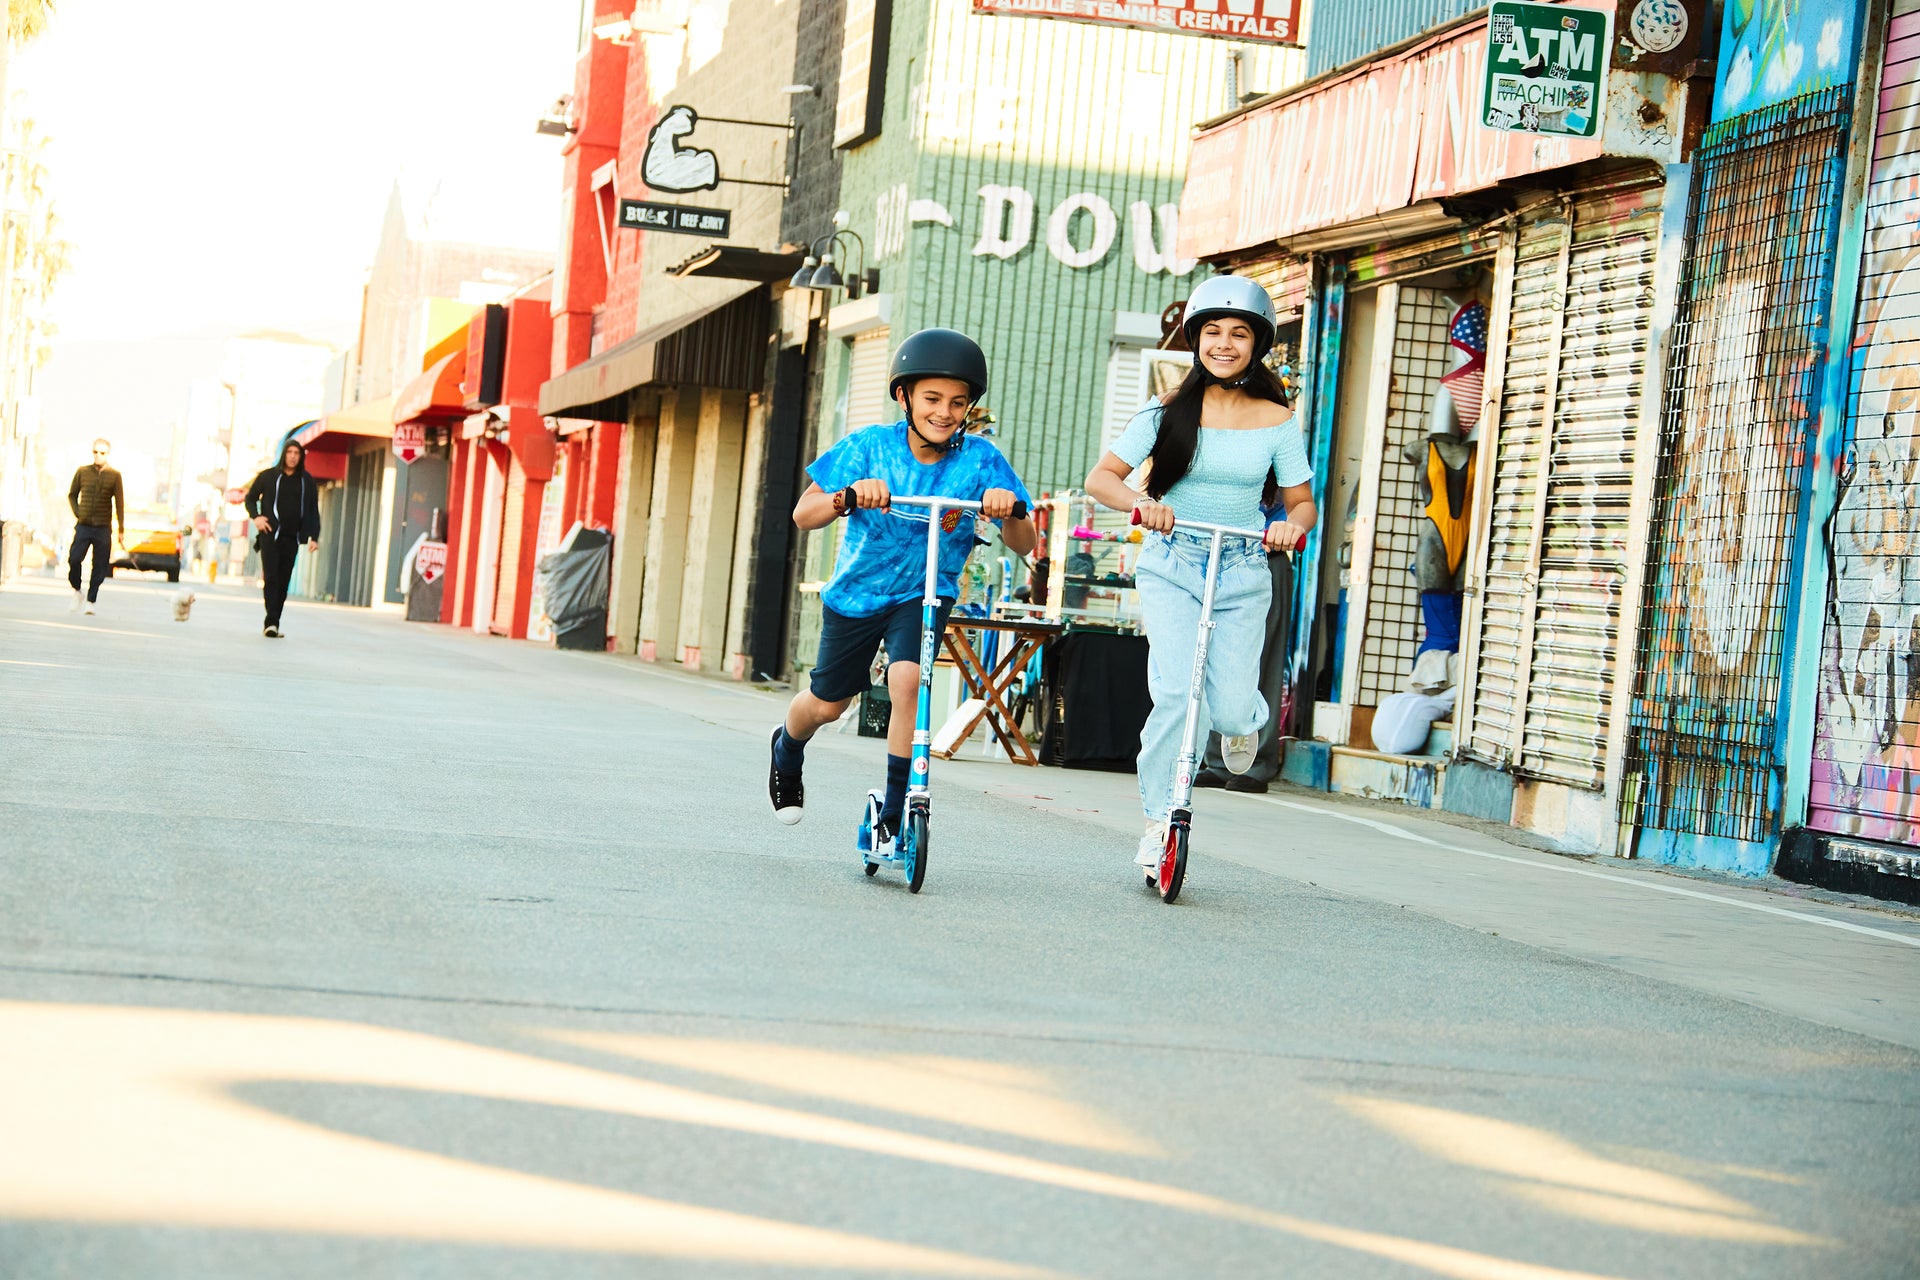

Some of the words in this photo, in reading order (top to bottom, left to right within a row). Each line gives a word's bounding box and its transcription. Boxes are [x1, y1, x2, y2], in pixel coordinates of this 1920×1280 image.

[1083, 2, 1171, 24] TENNIS
[1179, 10, 1289, 38] RENTALS
[1494, 34, 1513, 44] LSD
[1497, 26, 1596, 72] ATM
[1497, 82, 1576, 107] MACHIN
[699, 215, 725, 231] JERKY
[394, 425, 424, 440] ATM
[921, 630, 935, 686] Razor
